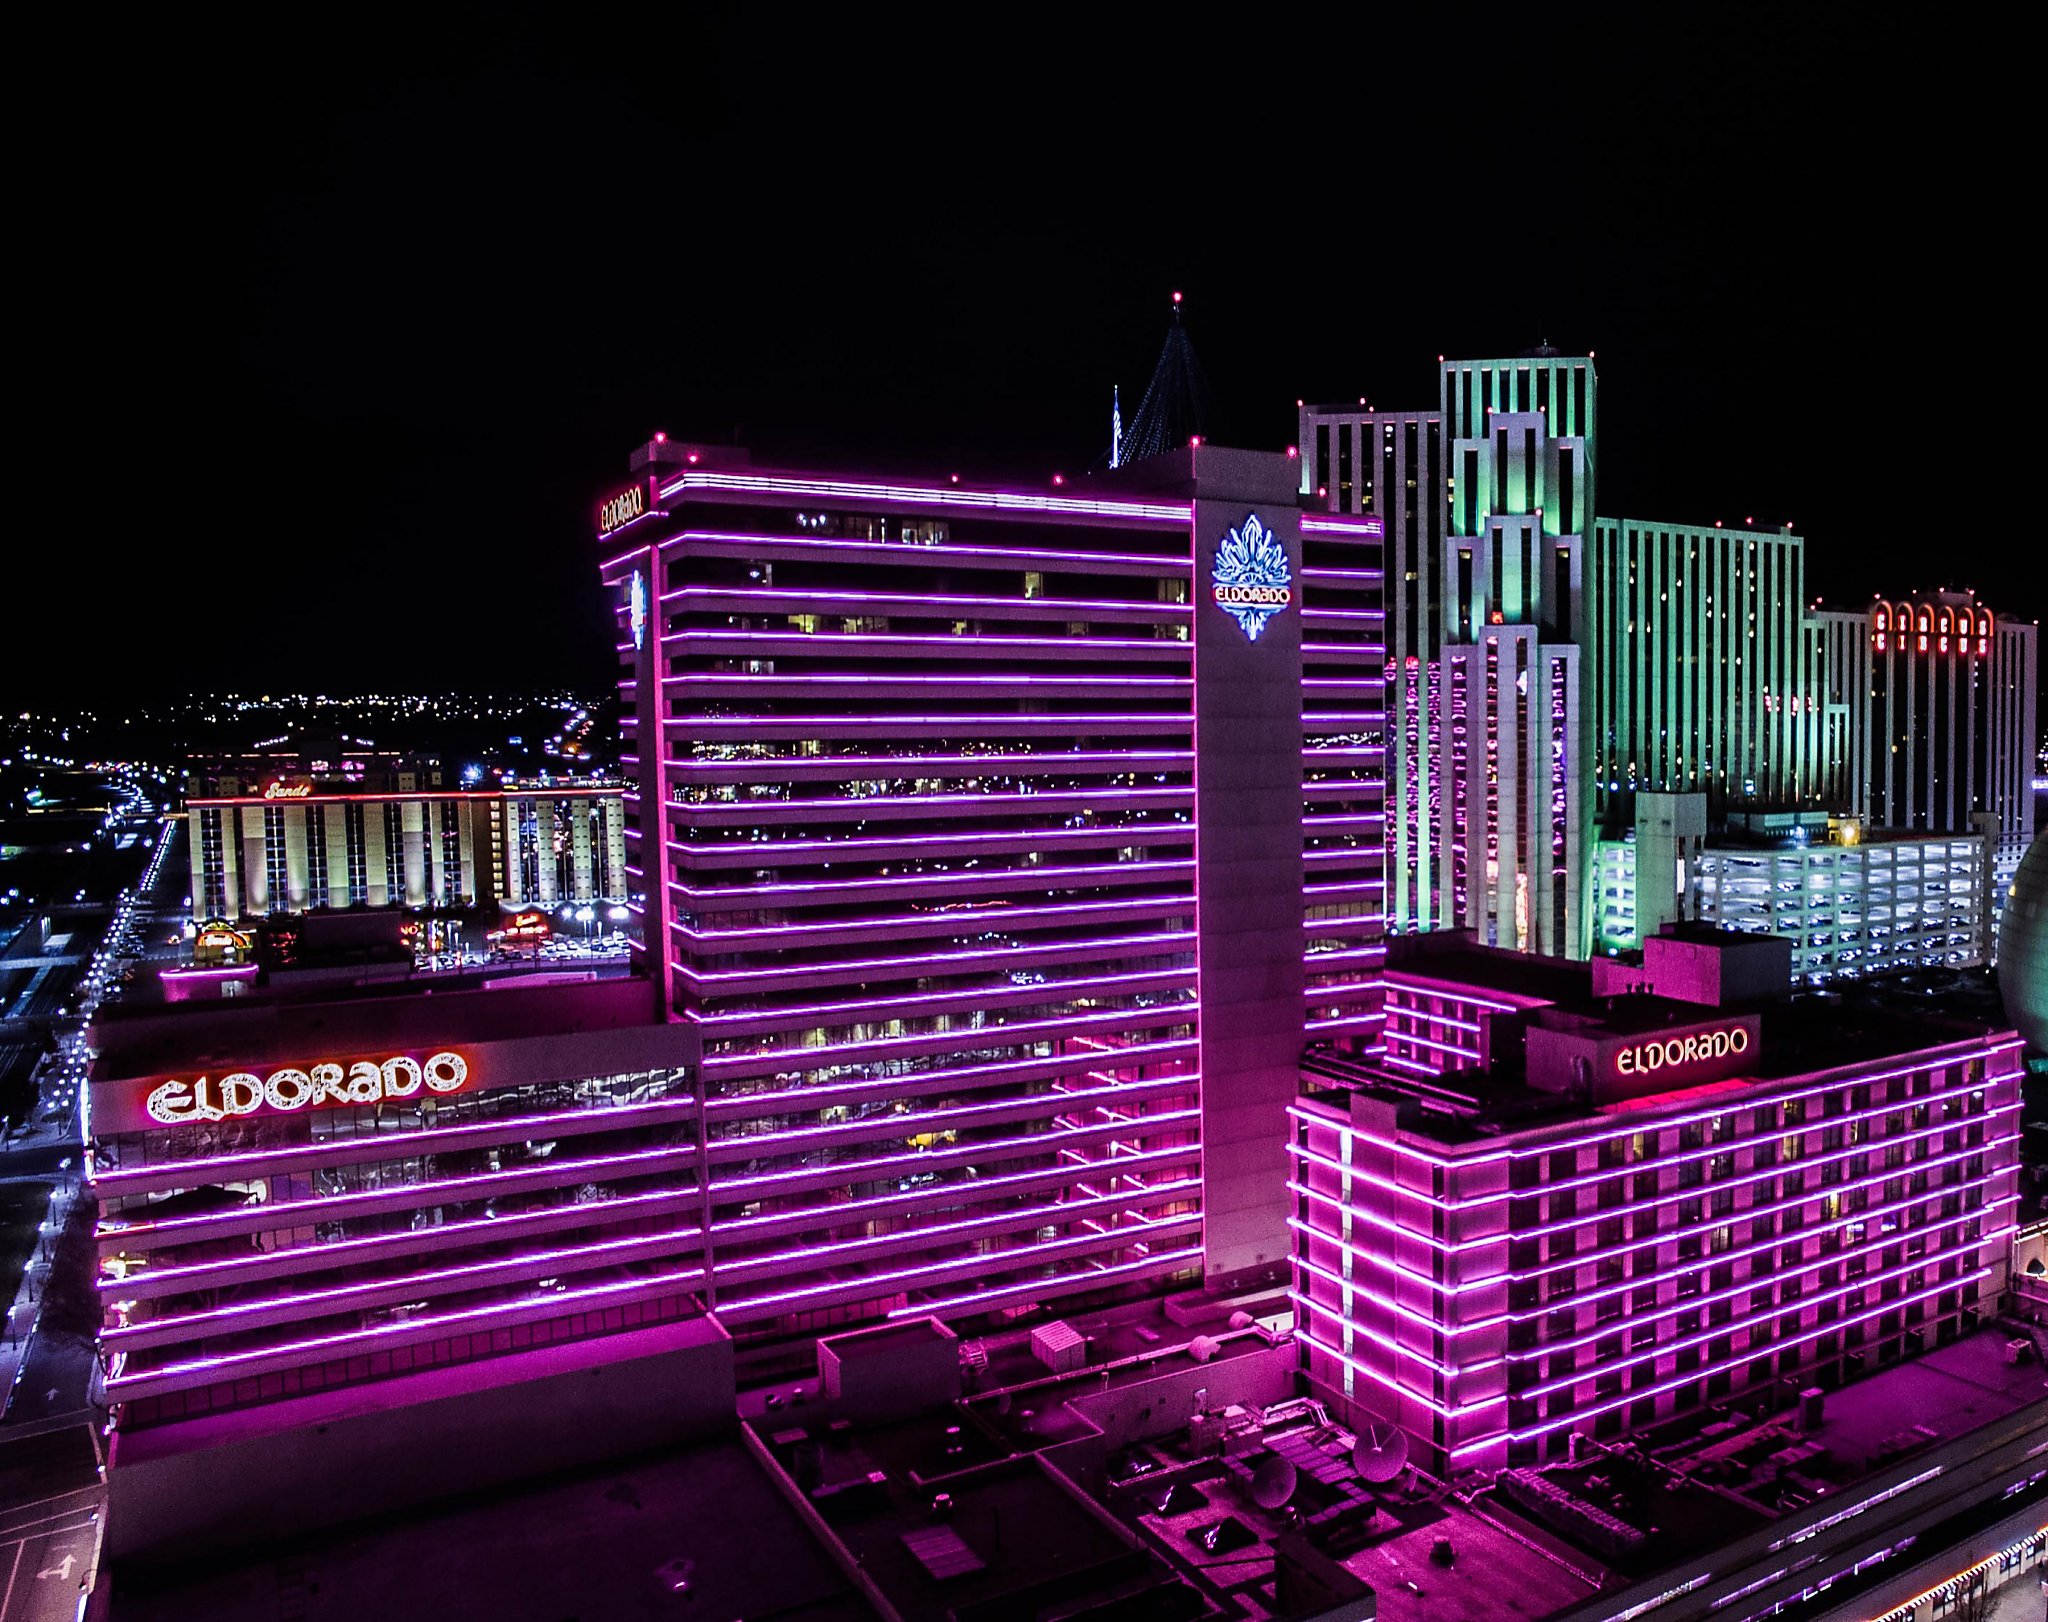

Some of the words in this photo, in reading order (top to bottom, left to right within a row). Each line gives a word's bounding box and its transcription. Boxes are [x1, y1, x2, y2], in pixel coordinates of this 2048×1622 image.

[1877, 614, 1986, 635] CIRCUS
[1877, 633, 1986, 653] CIRCUS
[265, 782, 311, 799] Sands
